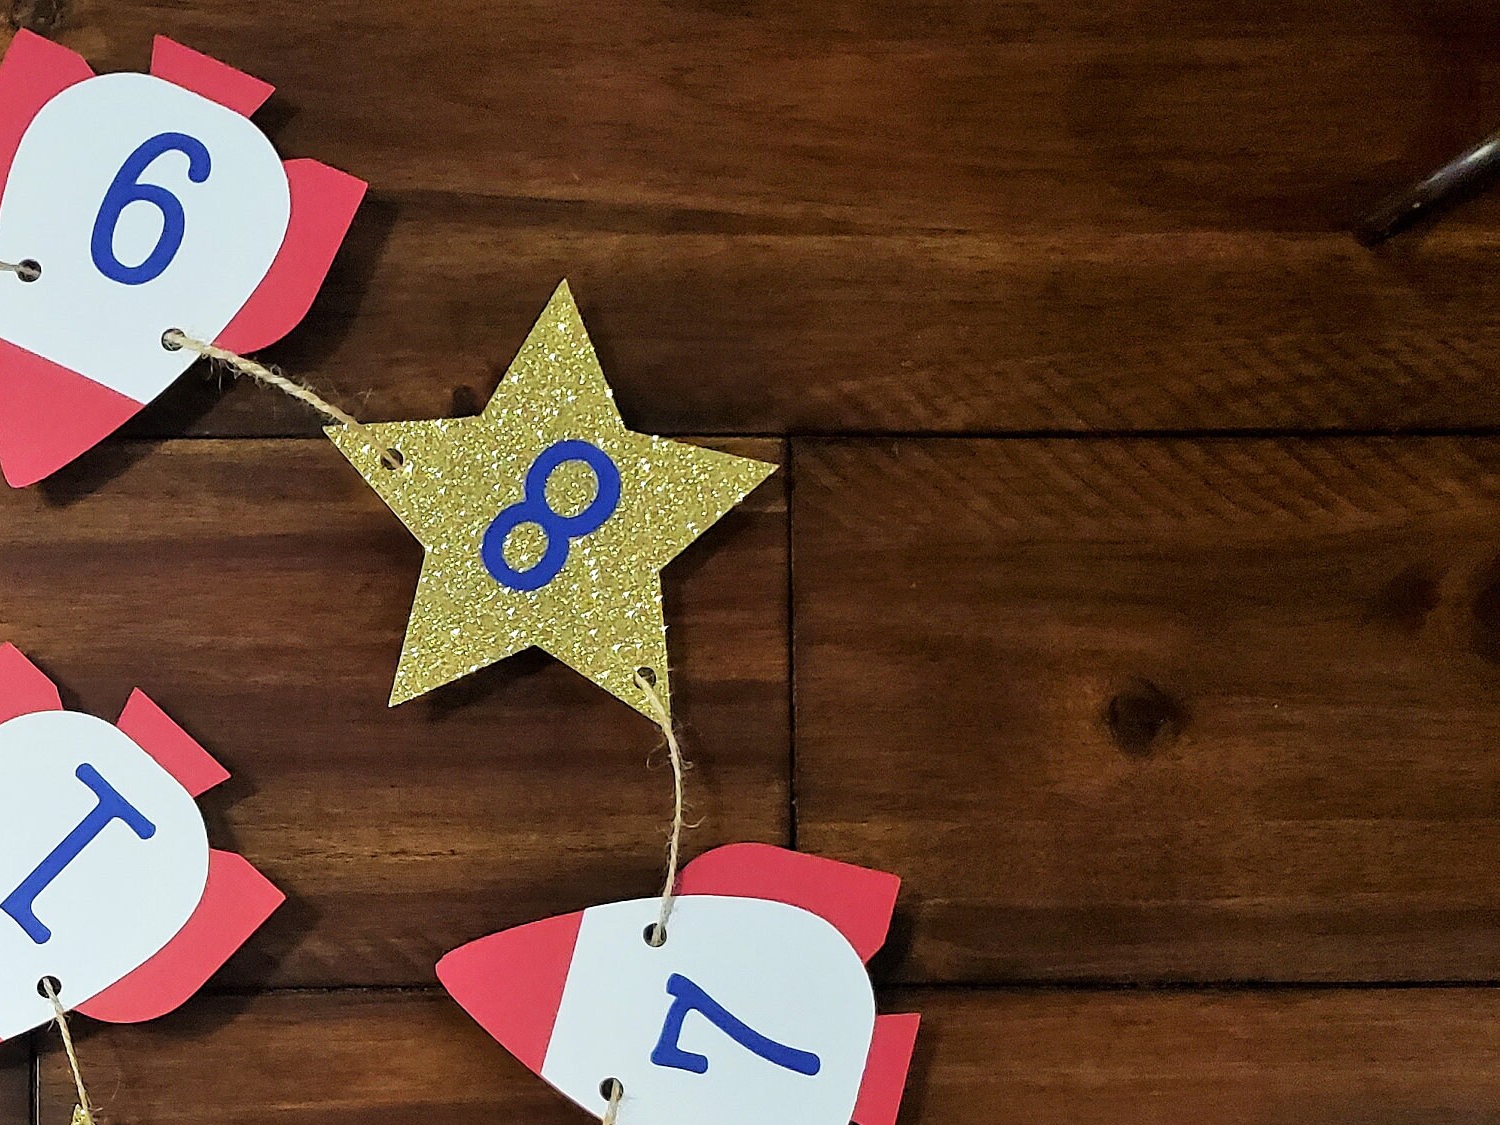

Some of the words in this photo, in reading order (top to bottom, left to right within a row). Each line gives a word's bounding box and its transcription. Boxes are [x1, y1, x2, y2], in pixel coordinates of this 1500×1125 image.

[481, 440, 620, 591] 8
[0, 763, 156, 943] 1
[651, 974, 820, 1075] 7
